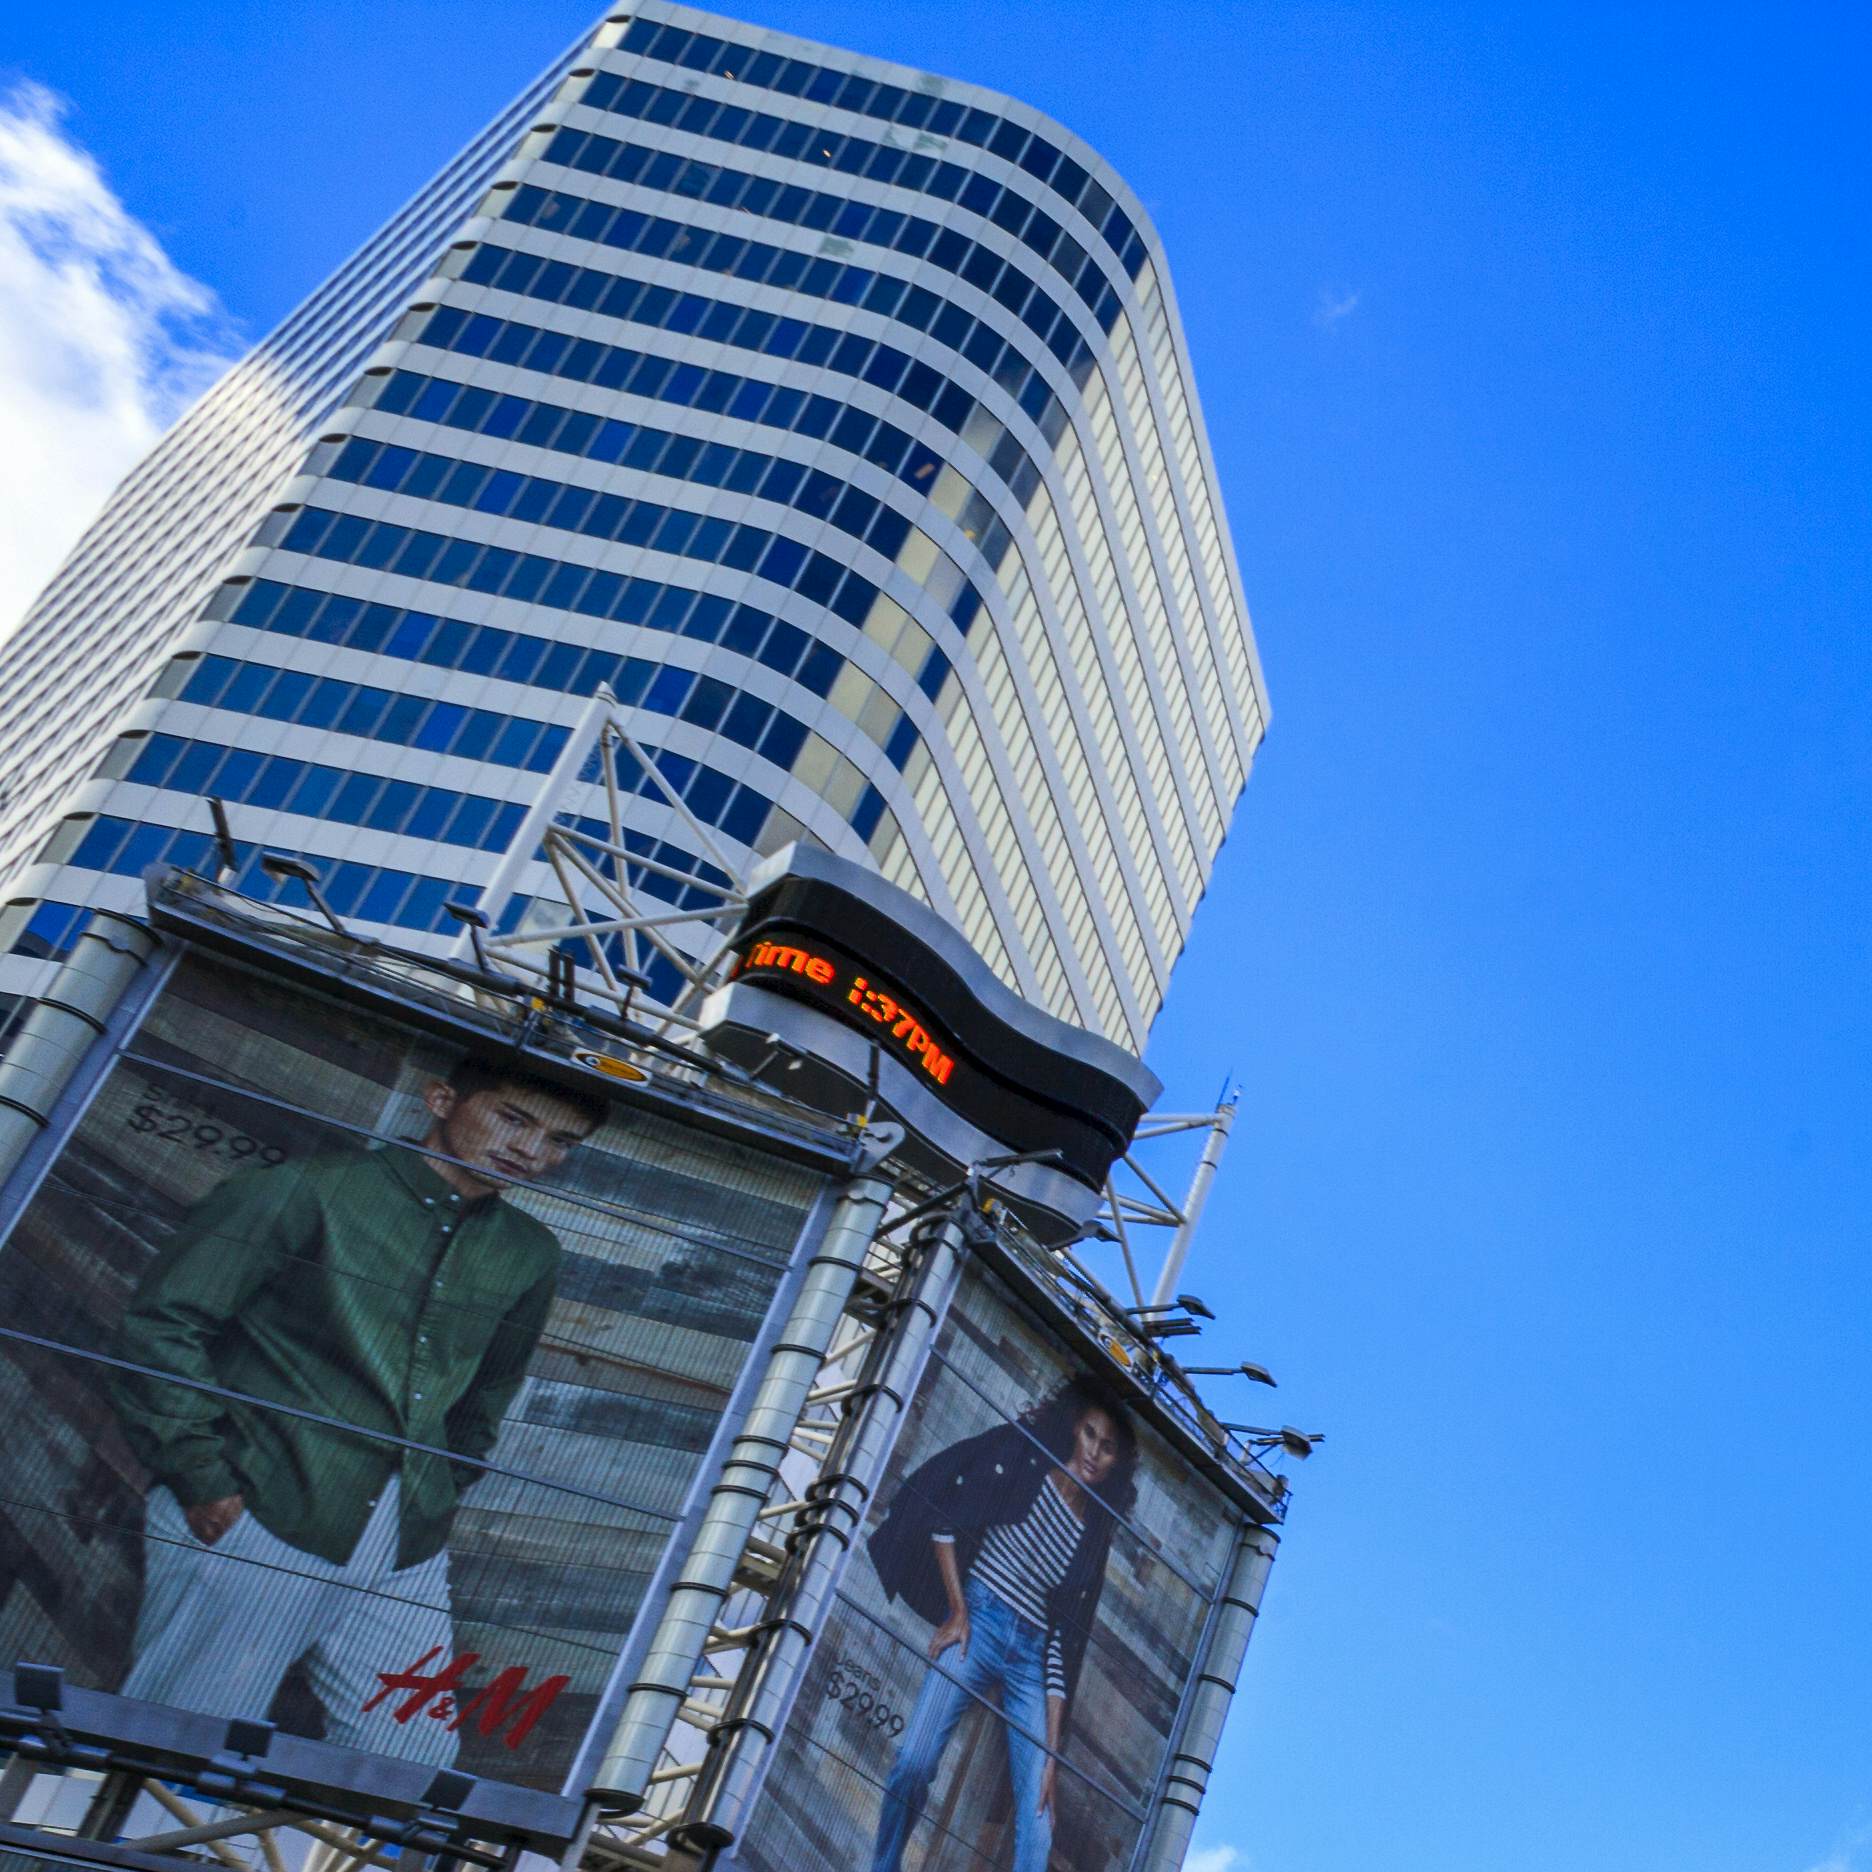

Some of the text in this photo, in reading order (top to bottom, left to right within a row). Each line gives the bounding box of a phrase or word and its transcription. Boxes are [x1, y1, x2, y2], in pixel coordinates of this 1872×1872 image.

[127, 1104, 288, 1170] $29.99
[361, 1646, 571, 1750] H&M
[827, 1671, 905, 1738] $29.99
